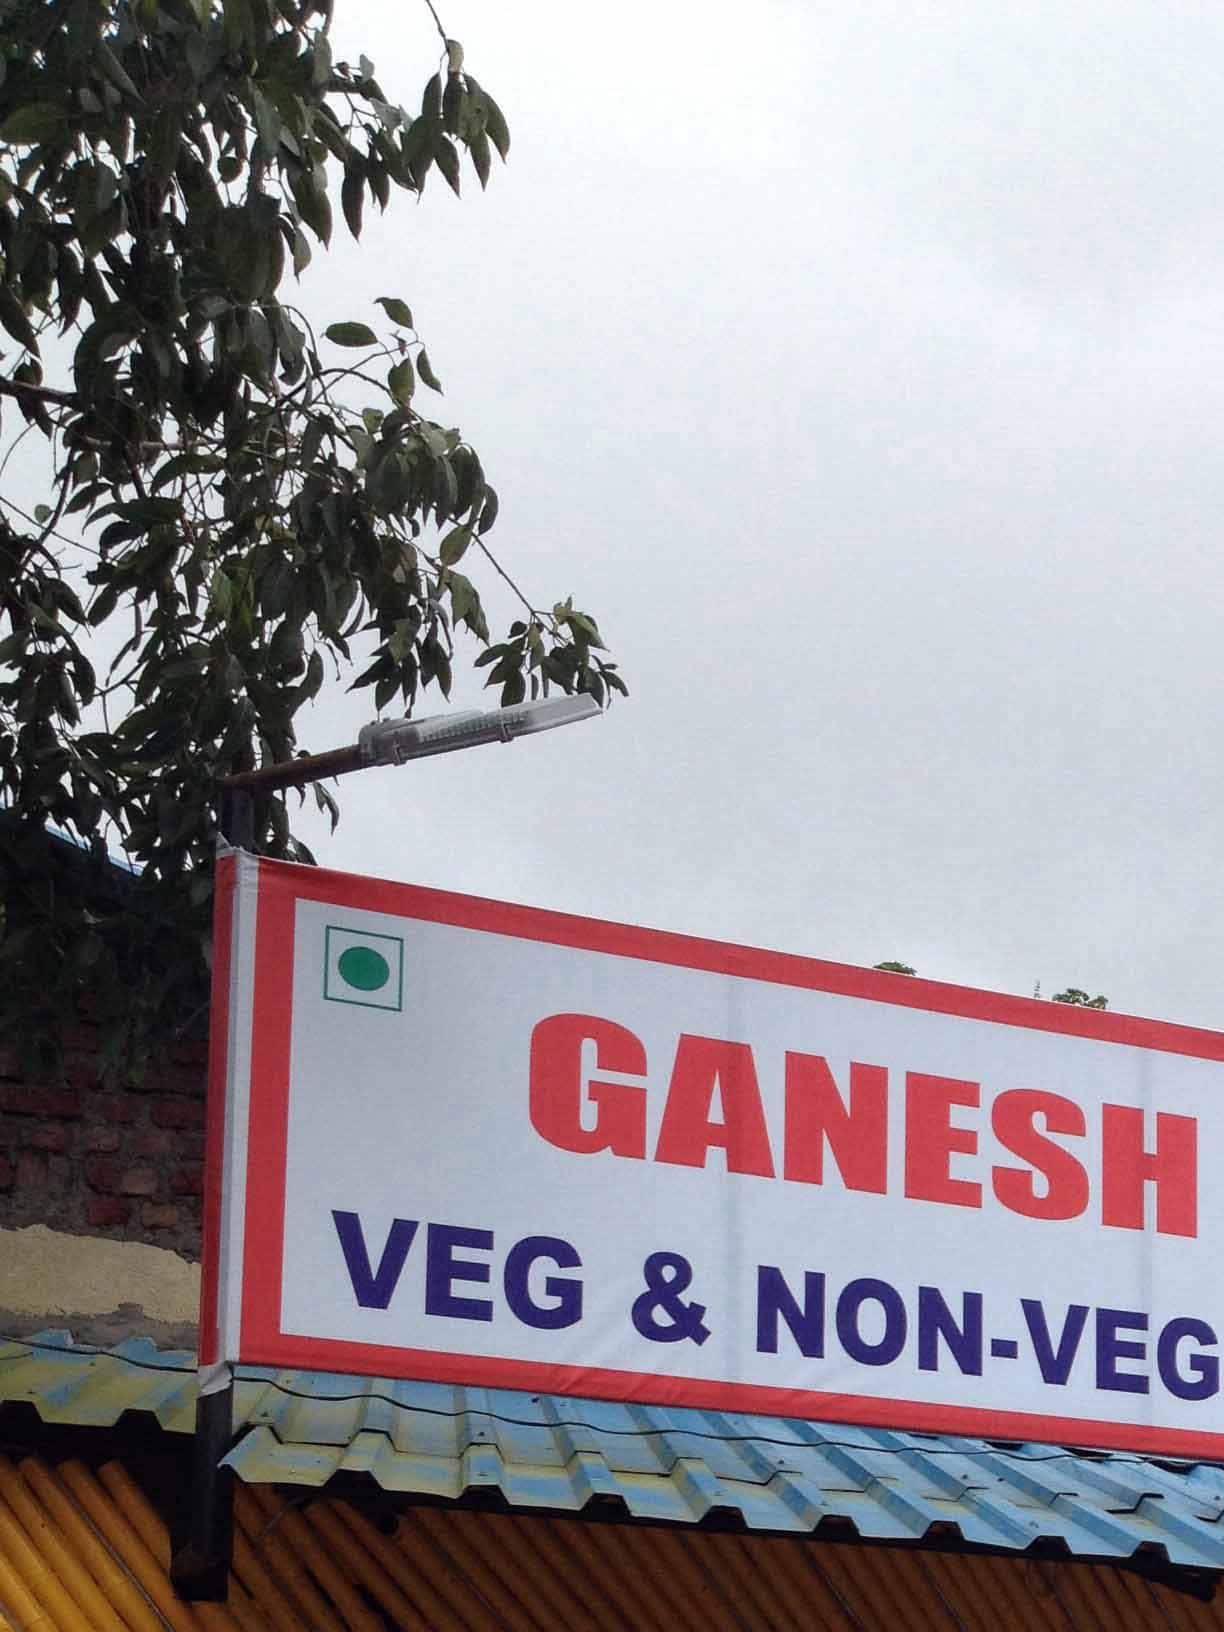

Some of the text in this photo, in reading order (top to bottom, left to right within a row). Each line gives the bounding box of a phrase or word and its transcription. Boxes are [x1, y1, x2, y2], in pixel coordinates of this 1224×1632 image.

[528, 1013, 1198, 1238] GANESH
[331, 1210, 584, 1330] VEG
[630, 1251, 711, 1346] &
[756, 1265, 1220, 1402] NON-VEG
